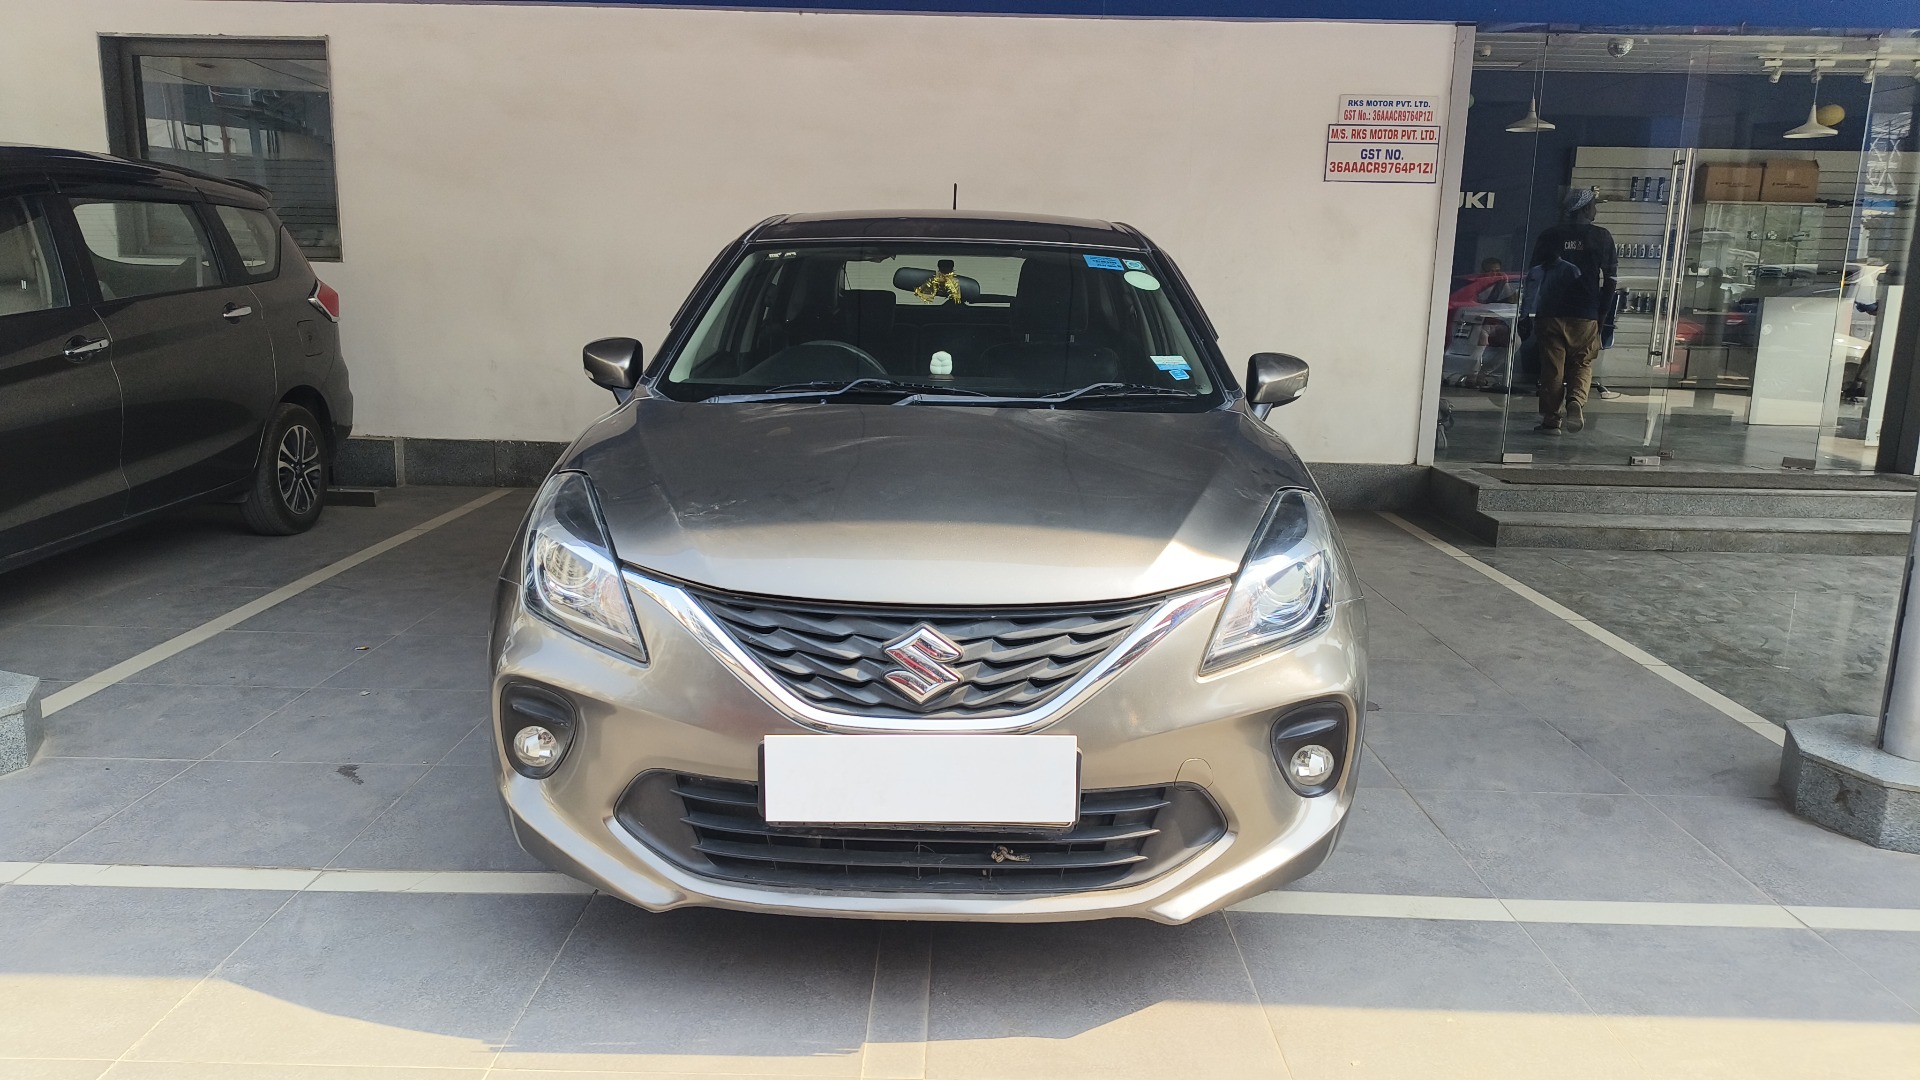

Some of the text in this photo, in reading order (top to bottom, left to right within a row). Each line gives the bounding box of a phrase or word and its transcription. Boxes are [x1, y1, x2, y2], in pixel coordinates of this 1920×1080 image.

[1344, 110, 1356, 120] GST
[1351, 129, 1367, 140] RKS
[1370, 129, 1399, 140] MOTOR
[1401, 130, 1418, 140] PVT.
[1421, 130, 1437, 140] LTD.
[1361, 149, 1404, 160] GST NO.
